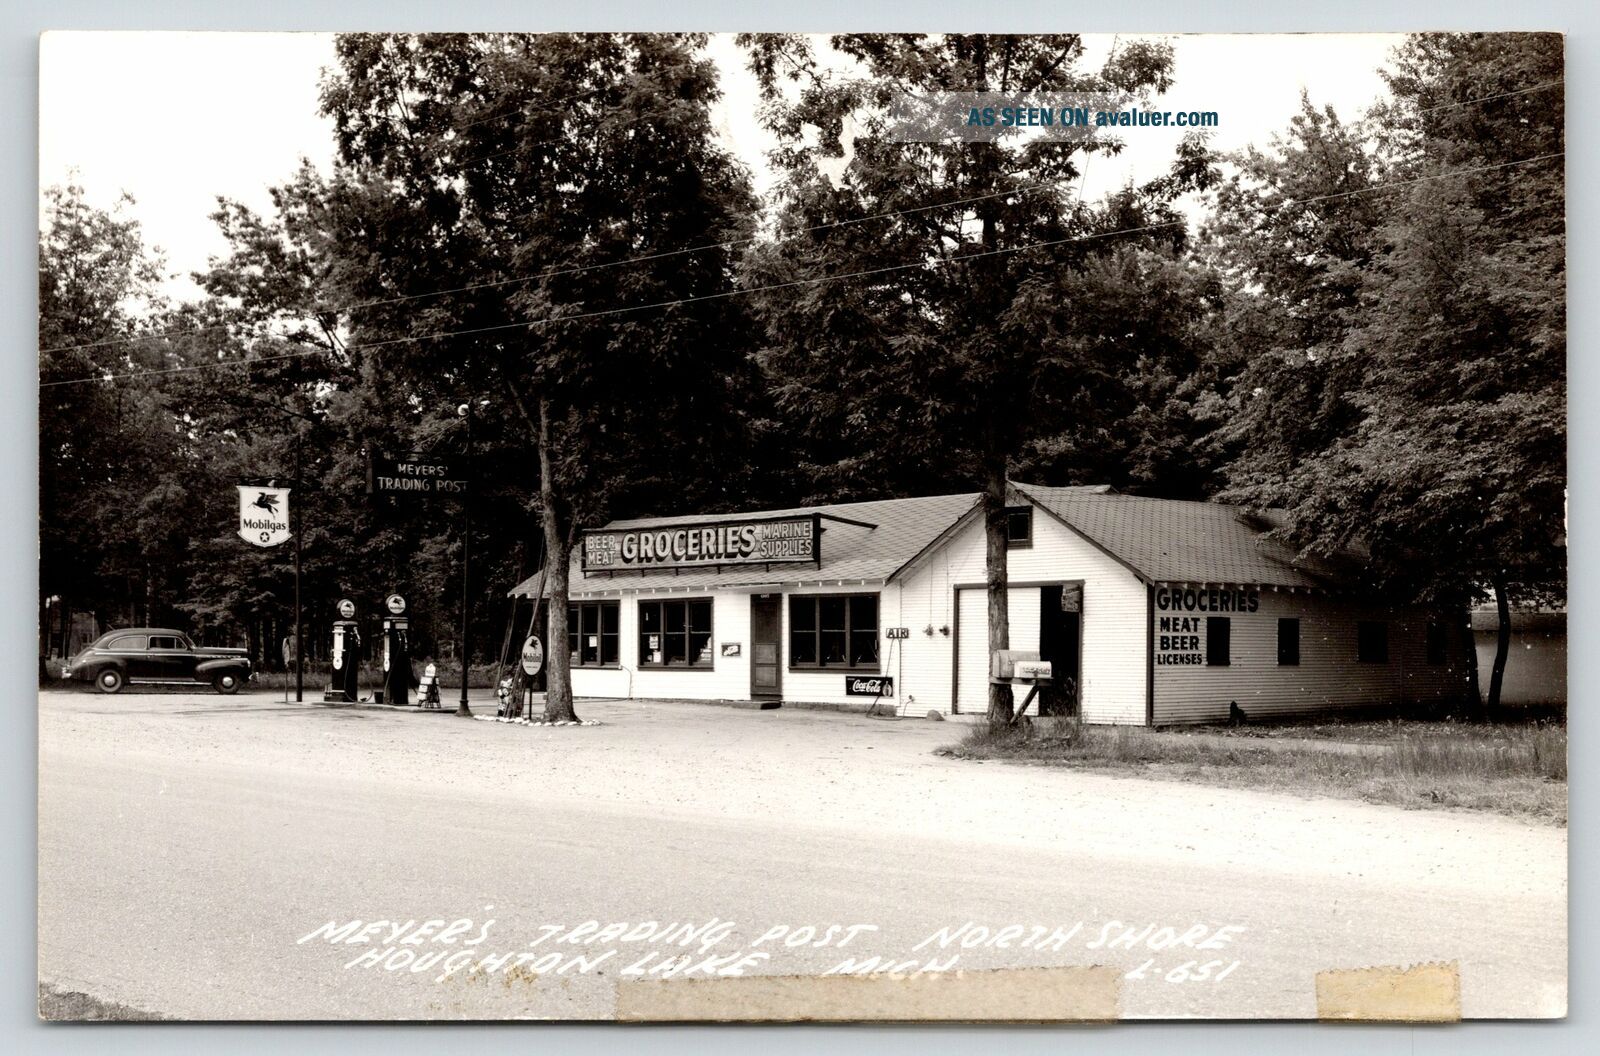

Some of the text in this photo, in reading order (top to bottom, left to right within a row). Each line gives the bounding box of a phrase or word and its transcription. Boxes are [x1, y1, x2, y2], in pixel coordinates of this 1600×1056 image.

[397, 463, 449, 477] MEYERS'
[377, 476, 469, 493] TRADING POST
[243, 518, 287, 534] Mobilgas
[761, 520, 811, 540] MARINE
[587, 534, 616, 551] BEER
[621, 524, 757, 564] GROCERIES
[759, 538, 813, 558] SUPPLIES
[587, 550, 616, 566] MEAT
[1157, 589, 1259, 612] GROCERIES
[1160, 617, 1200, 632] MEAT
[887, 628, 909, 638] AIR
[1160, 635, 1200, 651] BEER
[1157, 653, 1203, 666] LICENSES
